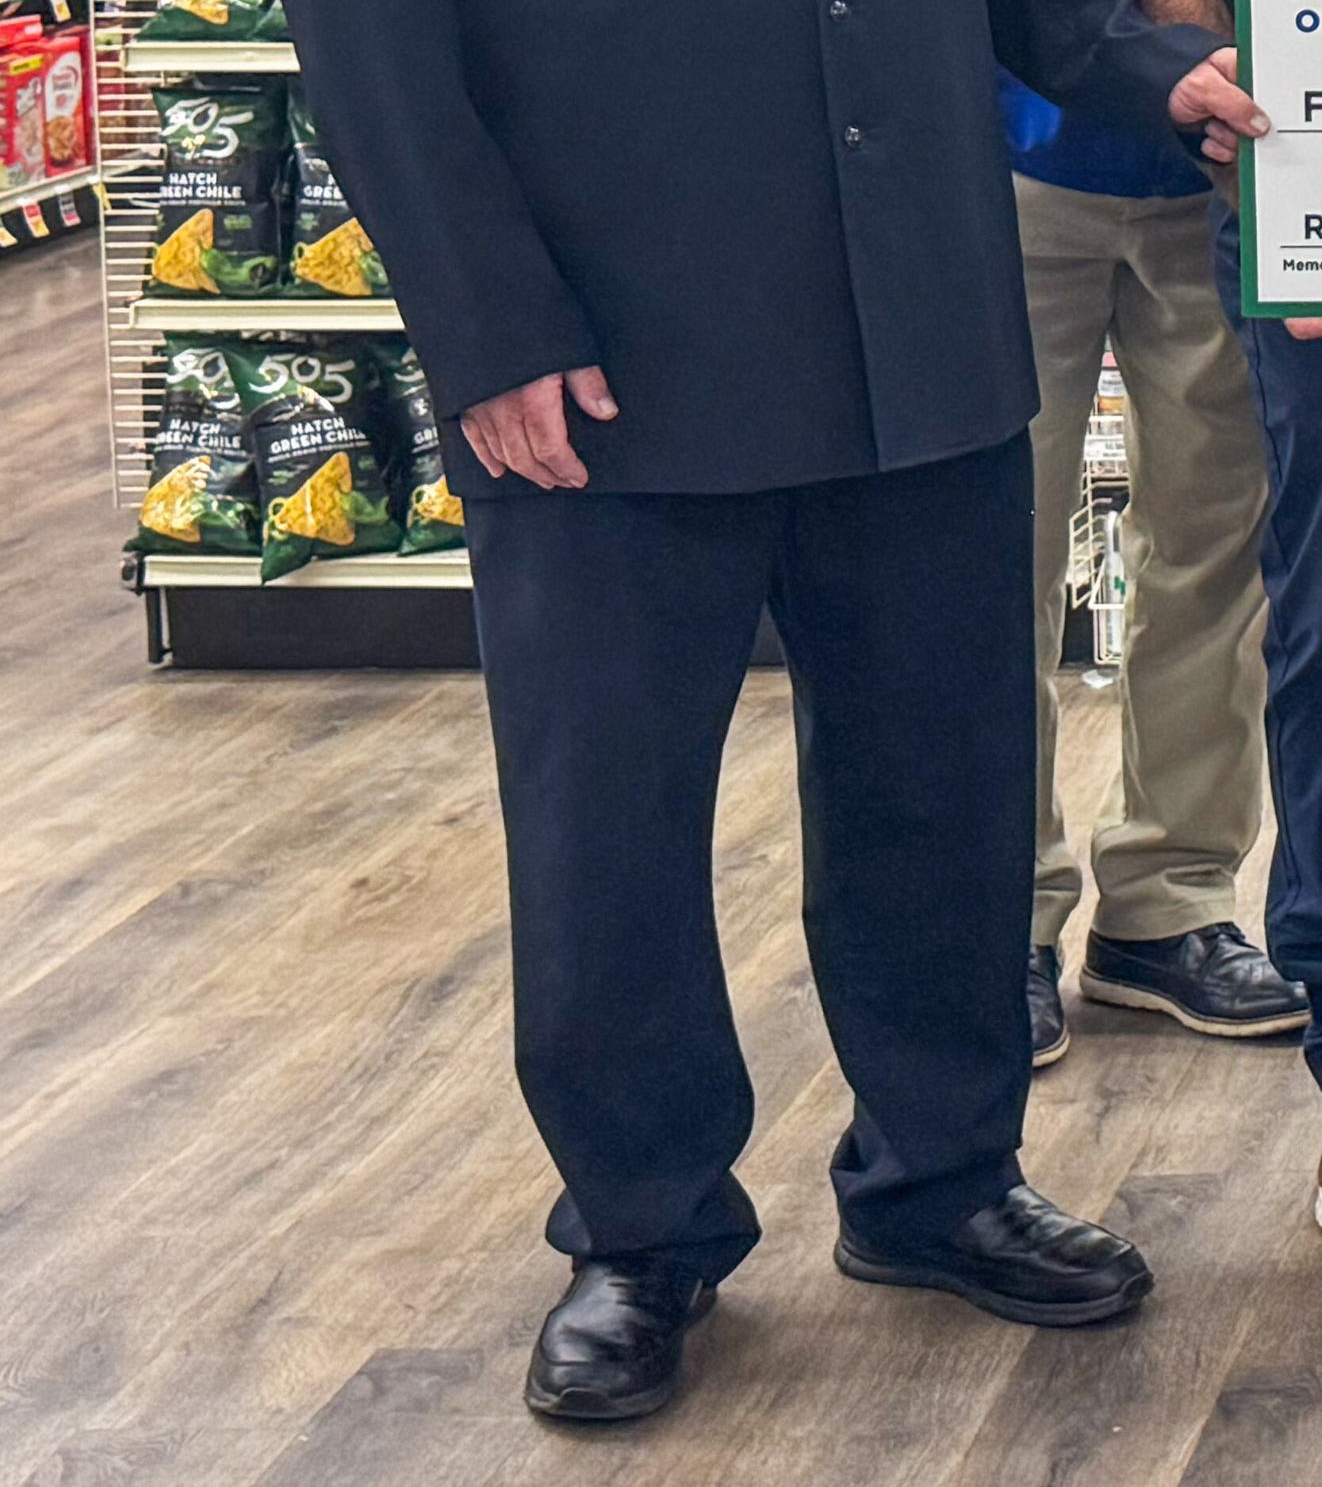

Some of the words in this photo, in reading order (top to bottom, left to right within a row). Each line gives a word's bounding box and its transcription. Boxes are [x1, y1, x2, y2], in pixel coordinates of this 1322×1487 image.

[169, 172, 217, 185] HATCH
[196, 185, 242, 199] CHILE
[304, 184, 344, 199] GREE
[249, 353, 355, 404] 505
[169, 418, 221, 435] HATCH
[291, 417, 345, 435] HATCH
[198, 434, 241, 449] CHILE
[271, 433, 323, 455] GREEN
